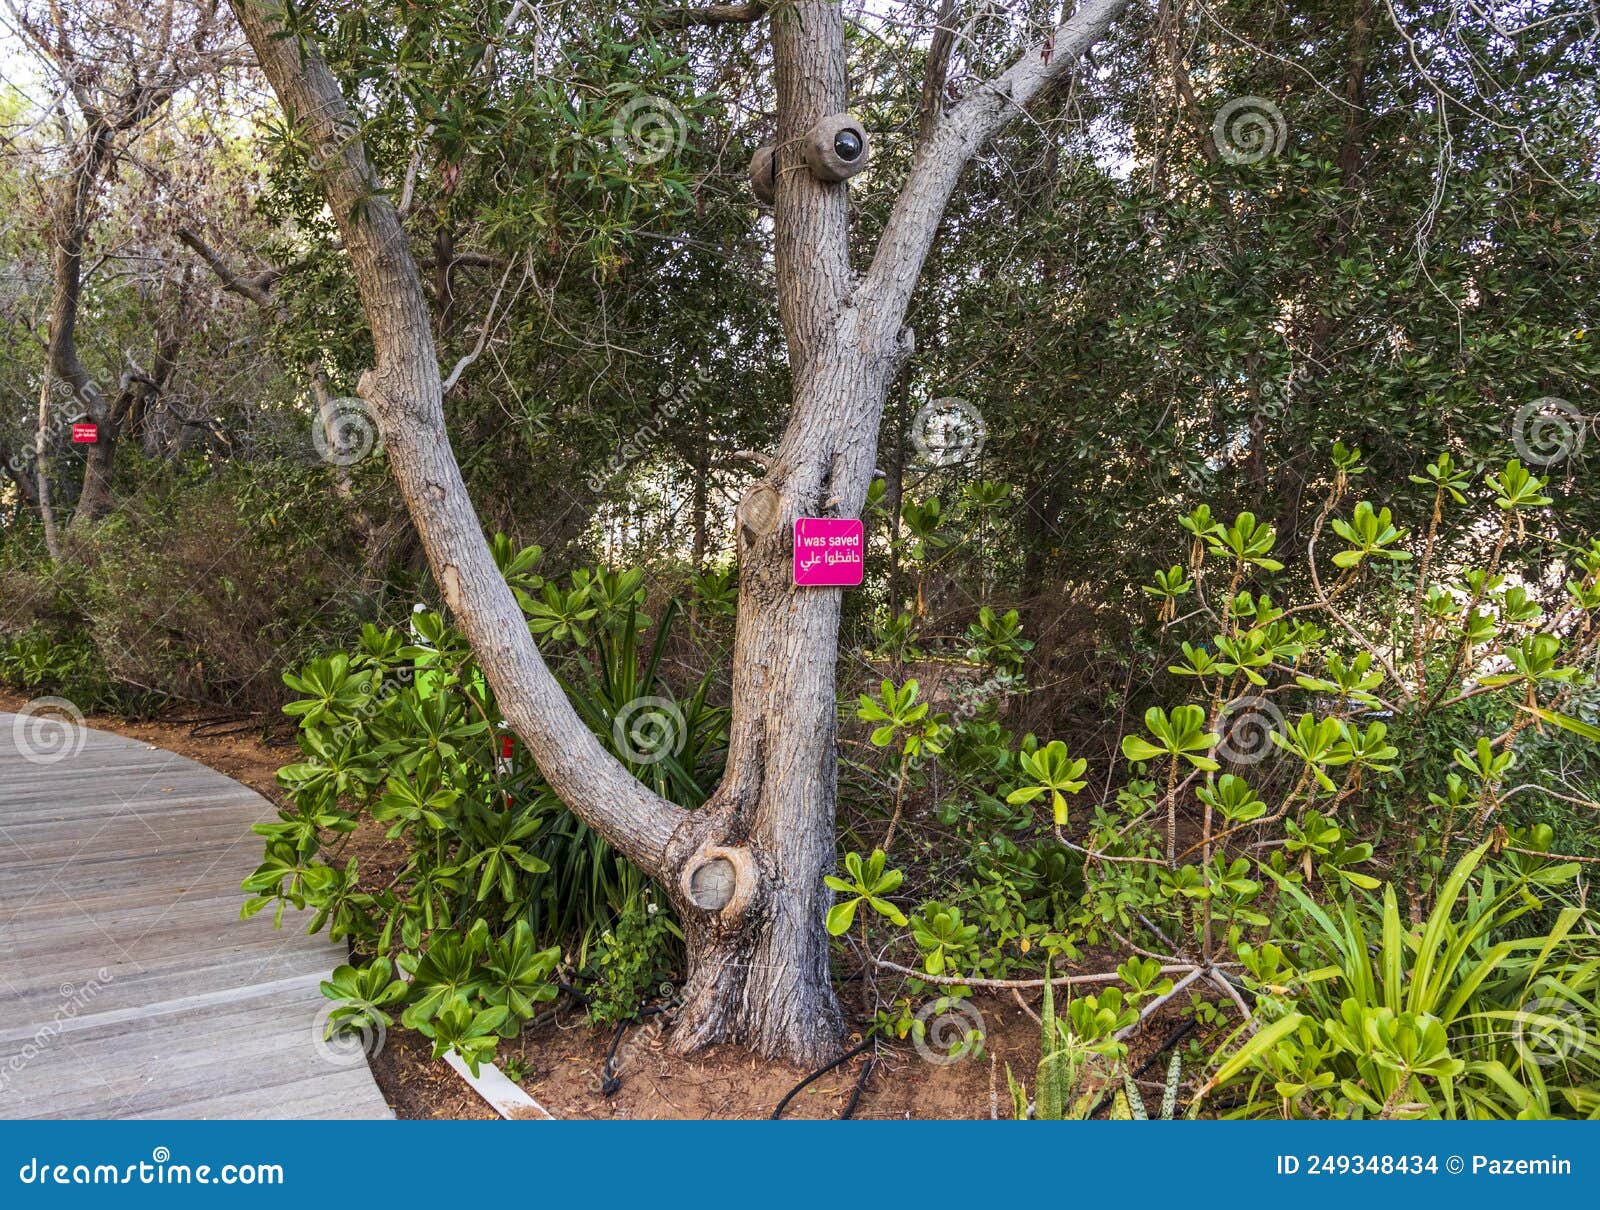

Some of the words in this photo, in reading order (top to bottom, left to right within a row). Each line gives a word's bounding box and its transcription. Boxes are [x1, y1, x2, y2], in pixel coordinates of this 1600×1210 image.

[797, 534, 801, 547] I
[804, 537, 825, 546] was
[829, 534, 858, 546] saved
